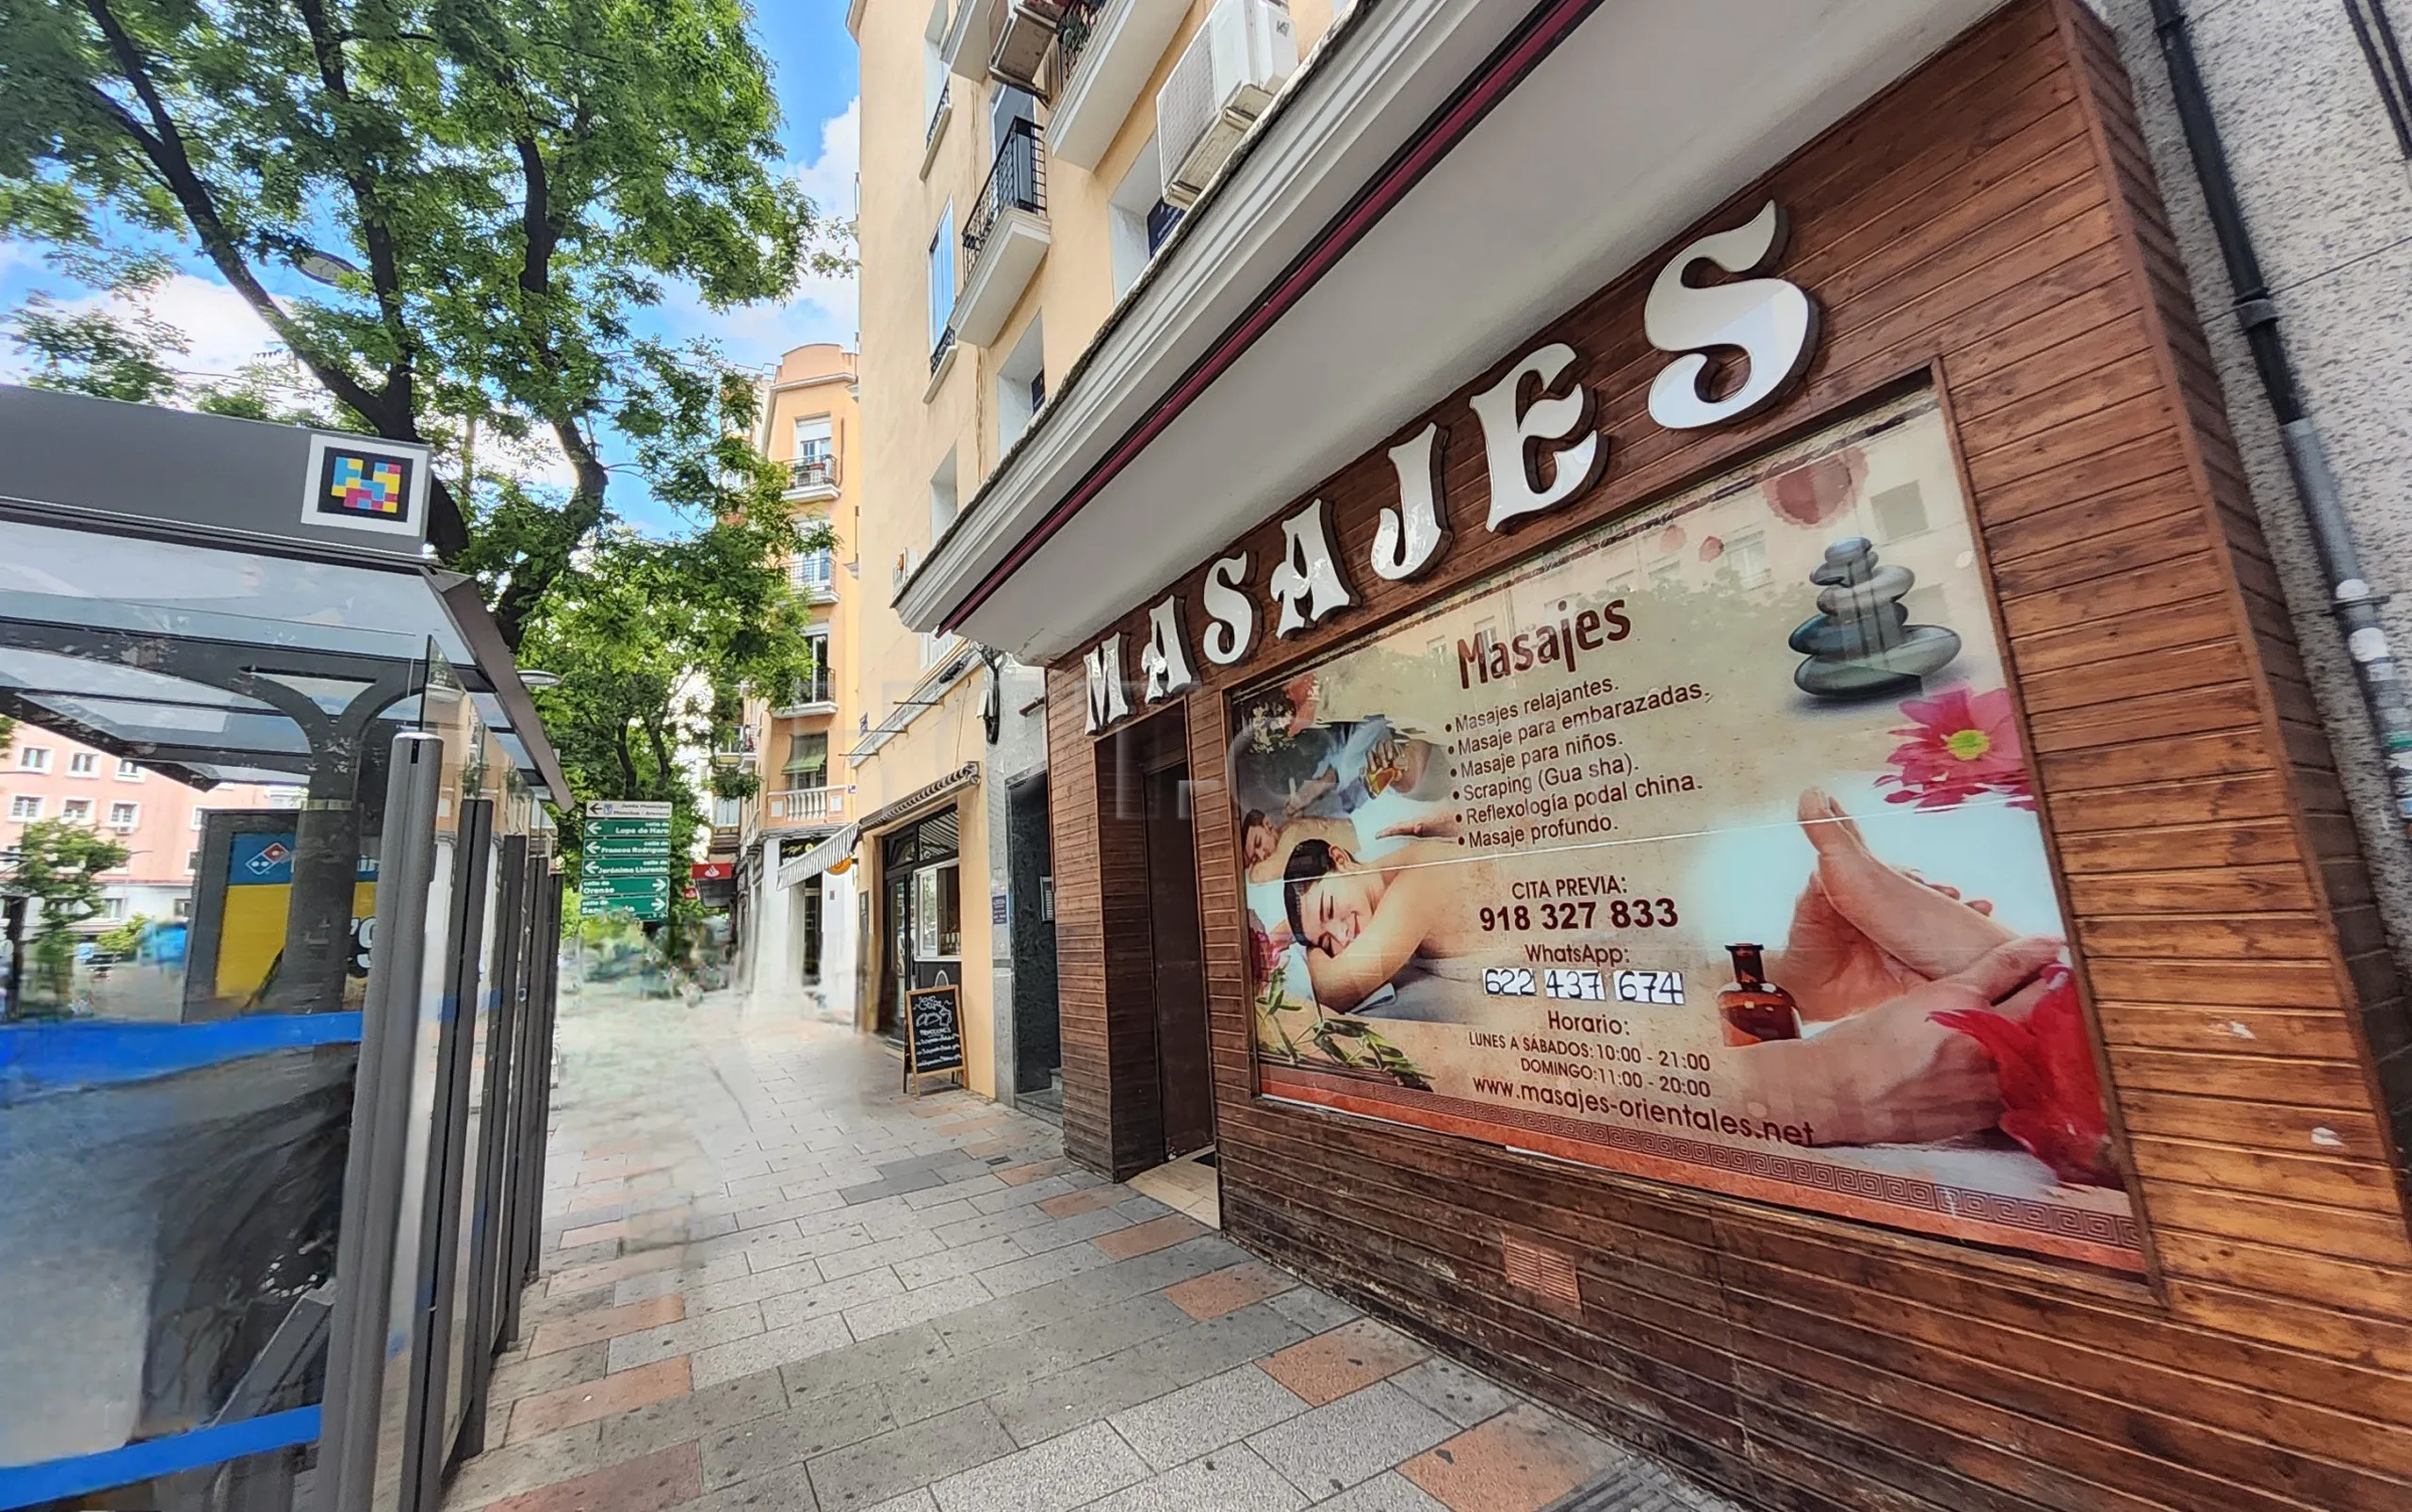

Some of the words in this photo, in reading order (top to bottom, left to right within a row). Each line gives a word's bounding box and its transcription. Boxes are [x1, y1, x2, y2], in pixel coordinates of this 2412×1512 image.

[1084, 200, 1815, 737] MASAJES
[1457, 599, 1631, 689] Masajes
[1456, 702, 1519, 733] Masajes
[1524, 678, 1620, 715] relajantes.
[1459, 728, 1512, 756] Masaje
[1518, 717, 1556, 742] para
[1460, 753, 1516, 779] Masaje
[1521, 744, 1559, 768] para
[1565, 730, 1623, 756] niños.
[1463, 775, 1532, 802] Scraping
[1538, 765, 1582, 792] (Gua
[1589, 753, 1639, 778] sha).
[1466, 793, 1568, 826] Reflexología
[1574, 781, 1628, 811] podal
[1635, 773, 1703, 800] china.
[1469, 822, 1524, 849] Masaje
[1530, 813, 1619, 845] profundo.
[1511, 881, 1552, 901] CITA
[1556, 874, 1628, 898] PREVIA:
[1479, 905, 1531, 932] 918
[1541, 902, 1597, 930] 327
[1610, 898, 1679, 929] 833
[1524, 943, 1631, 967] WhatsApp:
[1485, 968, 1537, 996] 622
[1546, 970, 1602, 1000] 437
[1619, 970, 1684, 1004] 674
[1548, 1010, 1630, 1035] Horario:
[1469, 1032, 1506, 1049] LUNES
[1510, 1038, 1520, 1050] A
[1658, 1050, 1711, 1072] 21:00
[1659, 1076, 1711, 1097] 20:00
[1473, 1077, 1815, 1146] www.masajes-orientales.net
